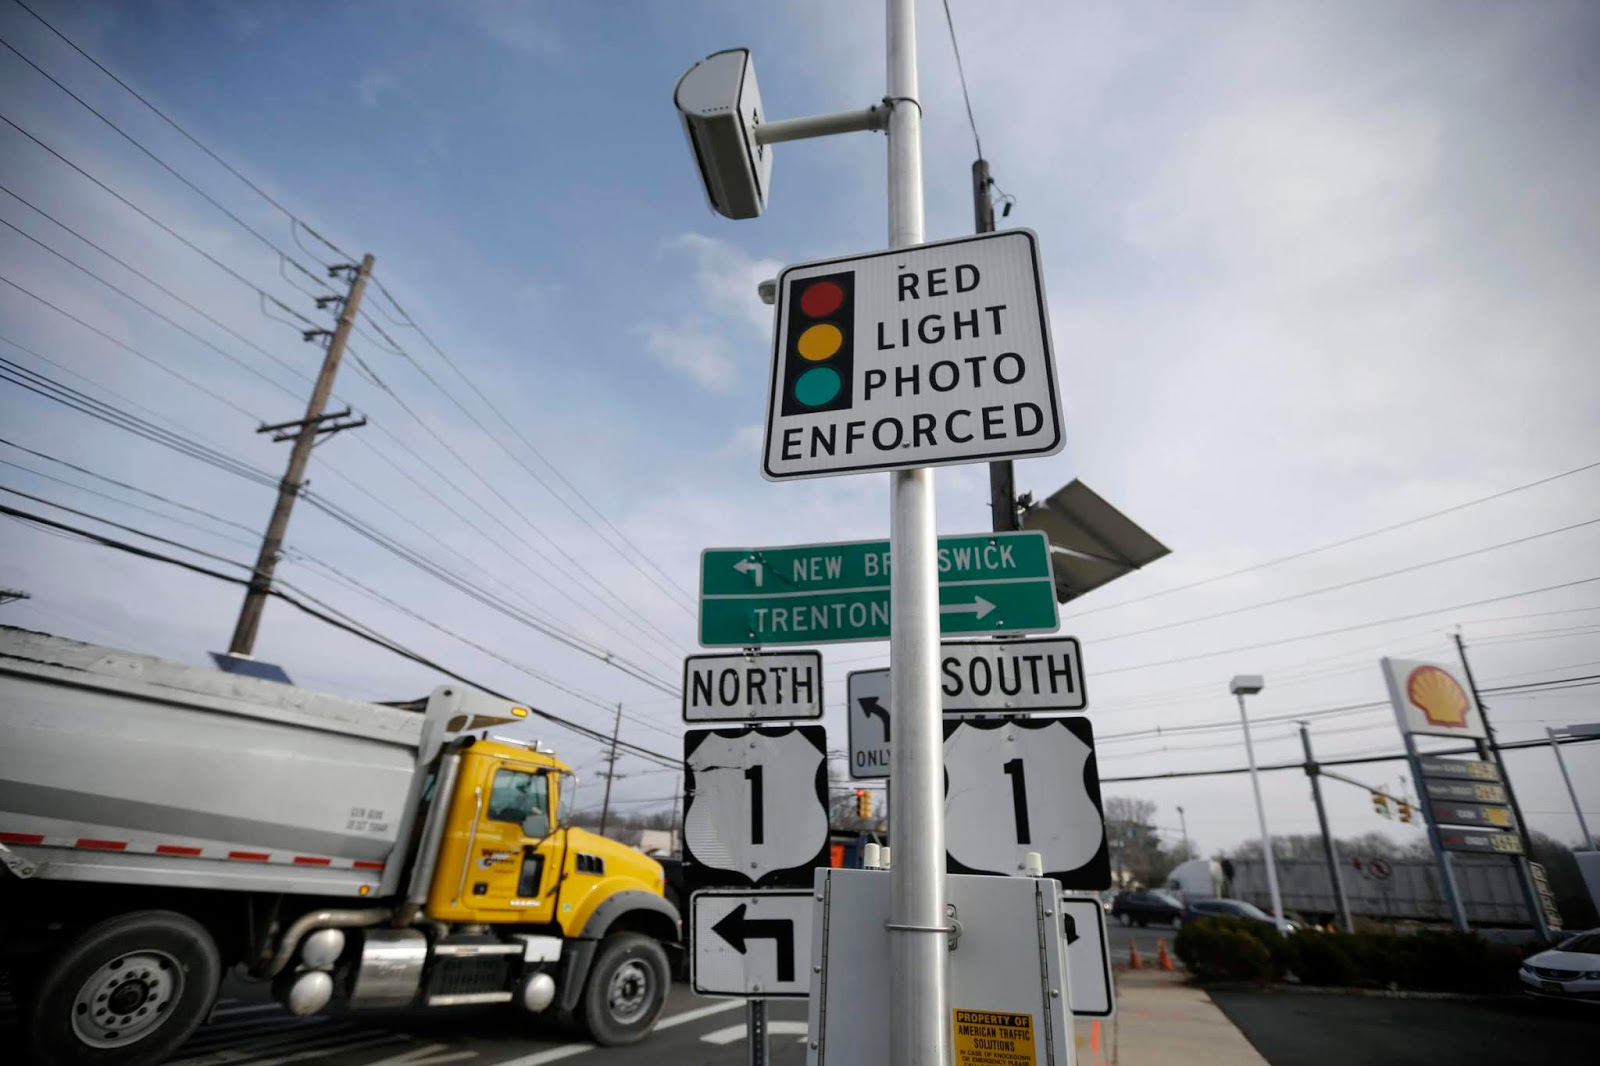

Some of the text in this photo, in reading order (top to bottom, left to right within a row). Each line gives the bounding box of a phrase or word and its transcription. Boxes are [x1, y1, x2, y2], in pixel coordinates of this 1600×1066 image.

[898, 264, 981, 302] RED
[877, 304, 1007, 350] LIGHT
[864, 352, 1026, 400] PHOTO
[781, 402, 1044, 460] ENFORCED
[793, 555, 842, 582] NEW
[754, 602, 889, 632] TRENTON
[692, 667, 813, 706] NORTH
[942, 654, 1074, 696] SOUTH
[744, 765, 764, 845] 1
[1003, 758, 1031, 845] 1
[958, 1012, 1028, 1026] PROPERTY OF
[958, 1025, 1030, 1040] AMERICAN TRAFFIC
[974, 1038, 1015, 1051] SOLUTIONS
